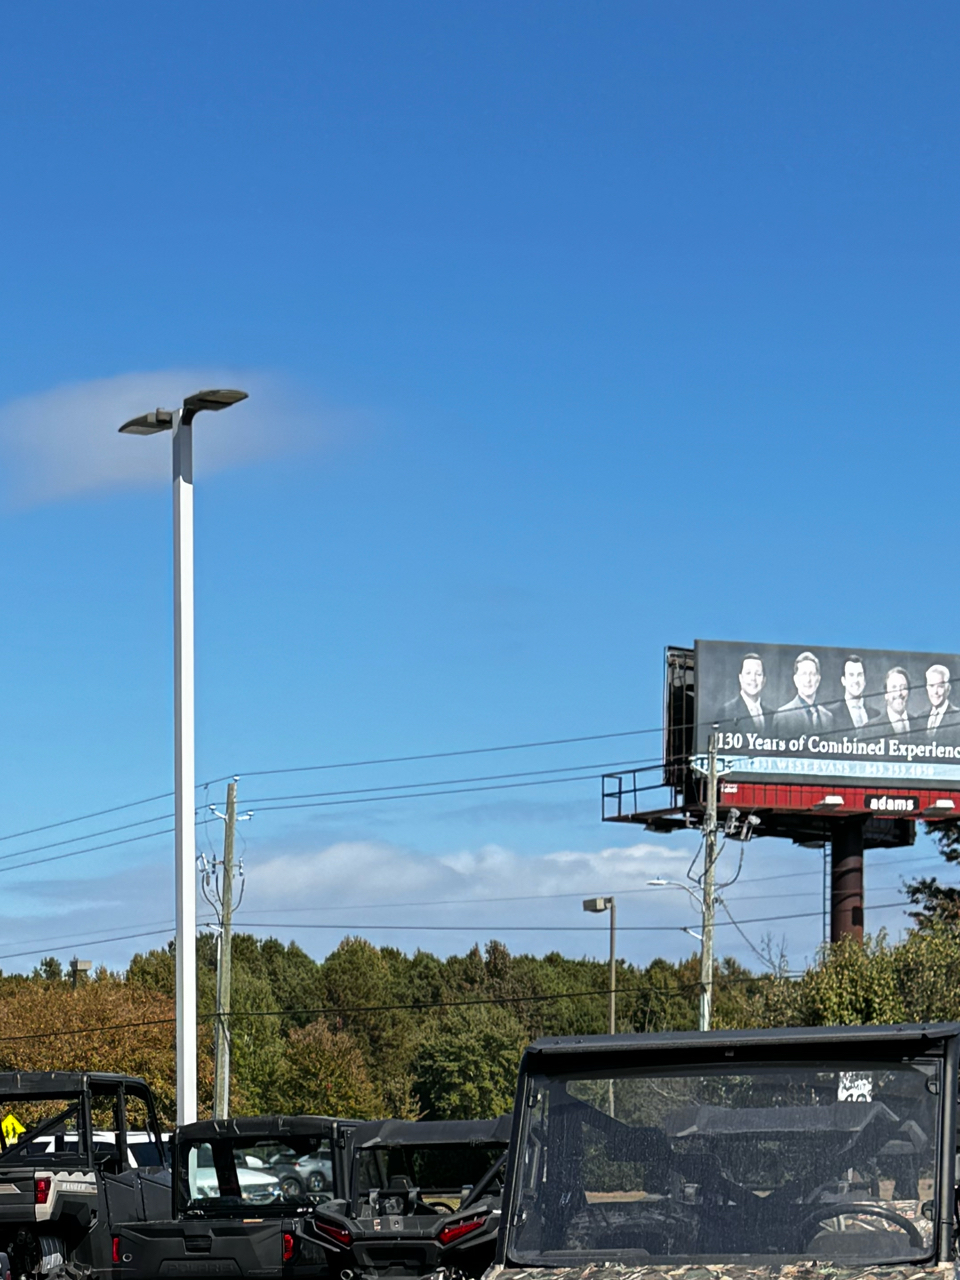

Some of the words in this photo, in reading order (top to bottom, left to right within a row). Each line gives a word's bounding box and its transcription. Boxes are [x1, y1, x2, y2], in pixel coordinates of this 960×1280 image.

[717, 732, 743, 749] 130
[746, 733, 786, 751] Years
[788, 734, 807, 751] of
[808, 736, 886, 755] Combined
[869, 796, 915, 811] adams
